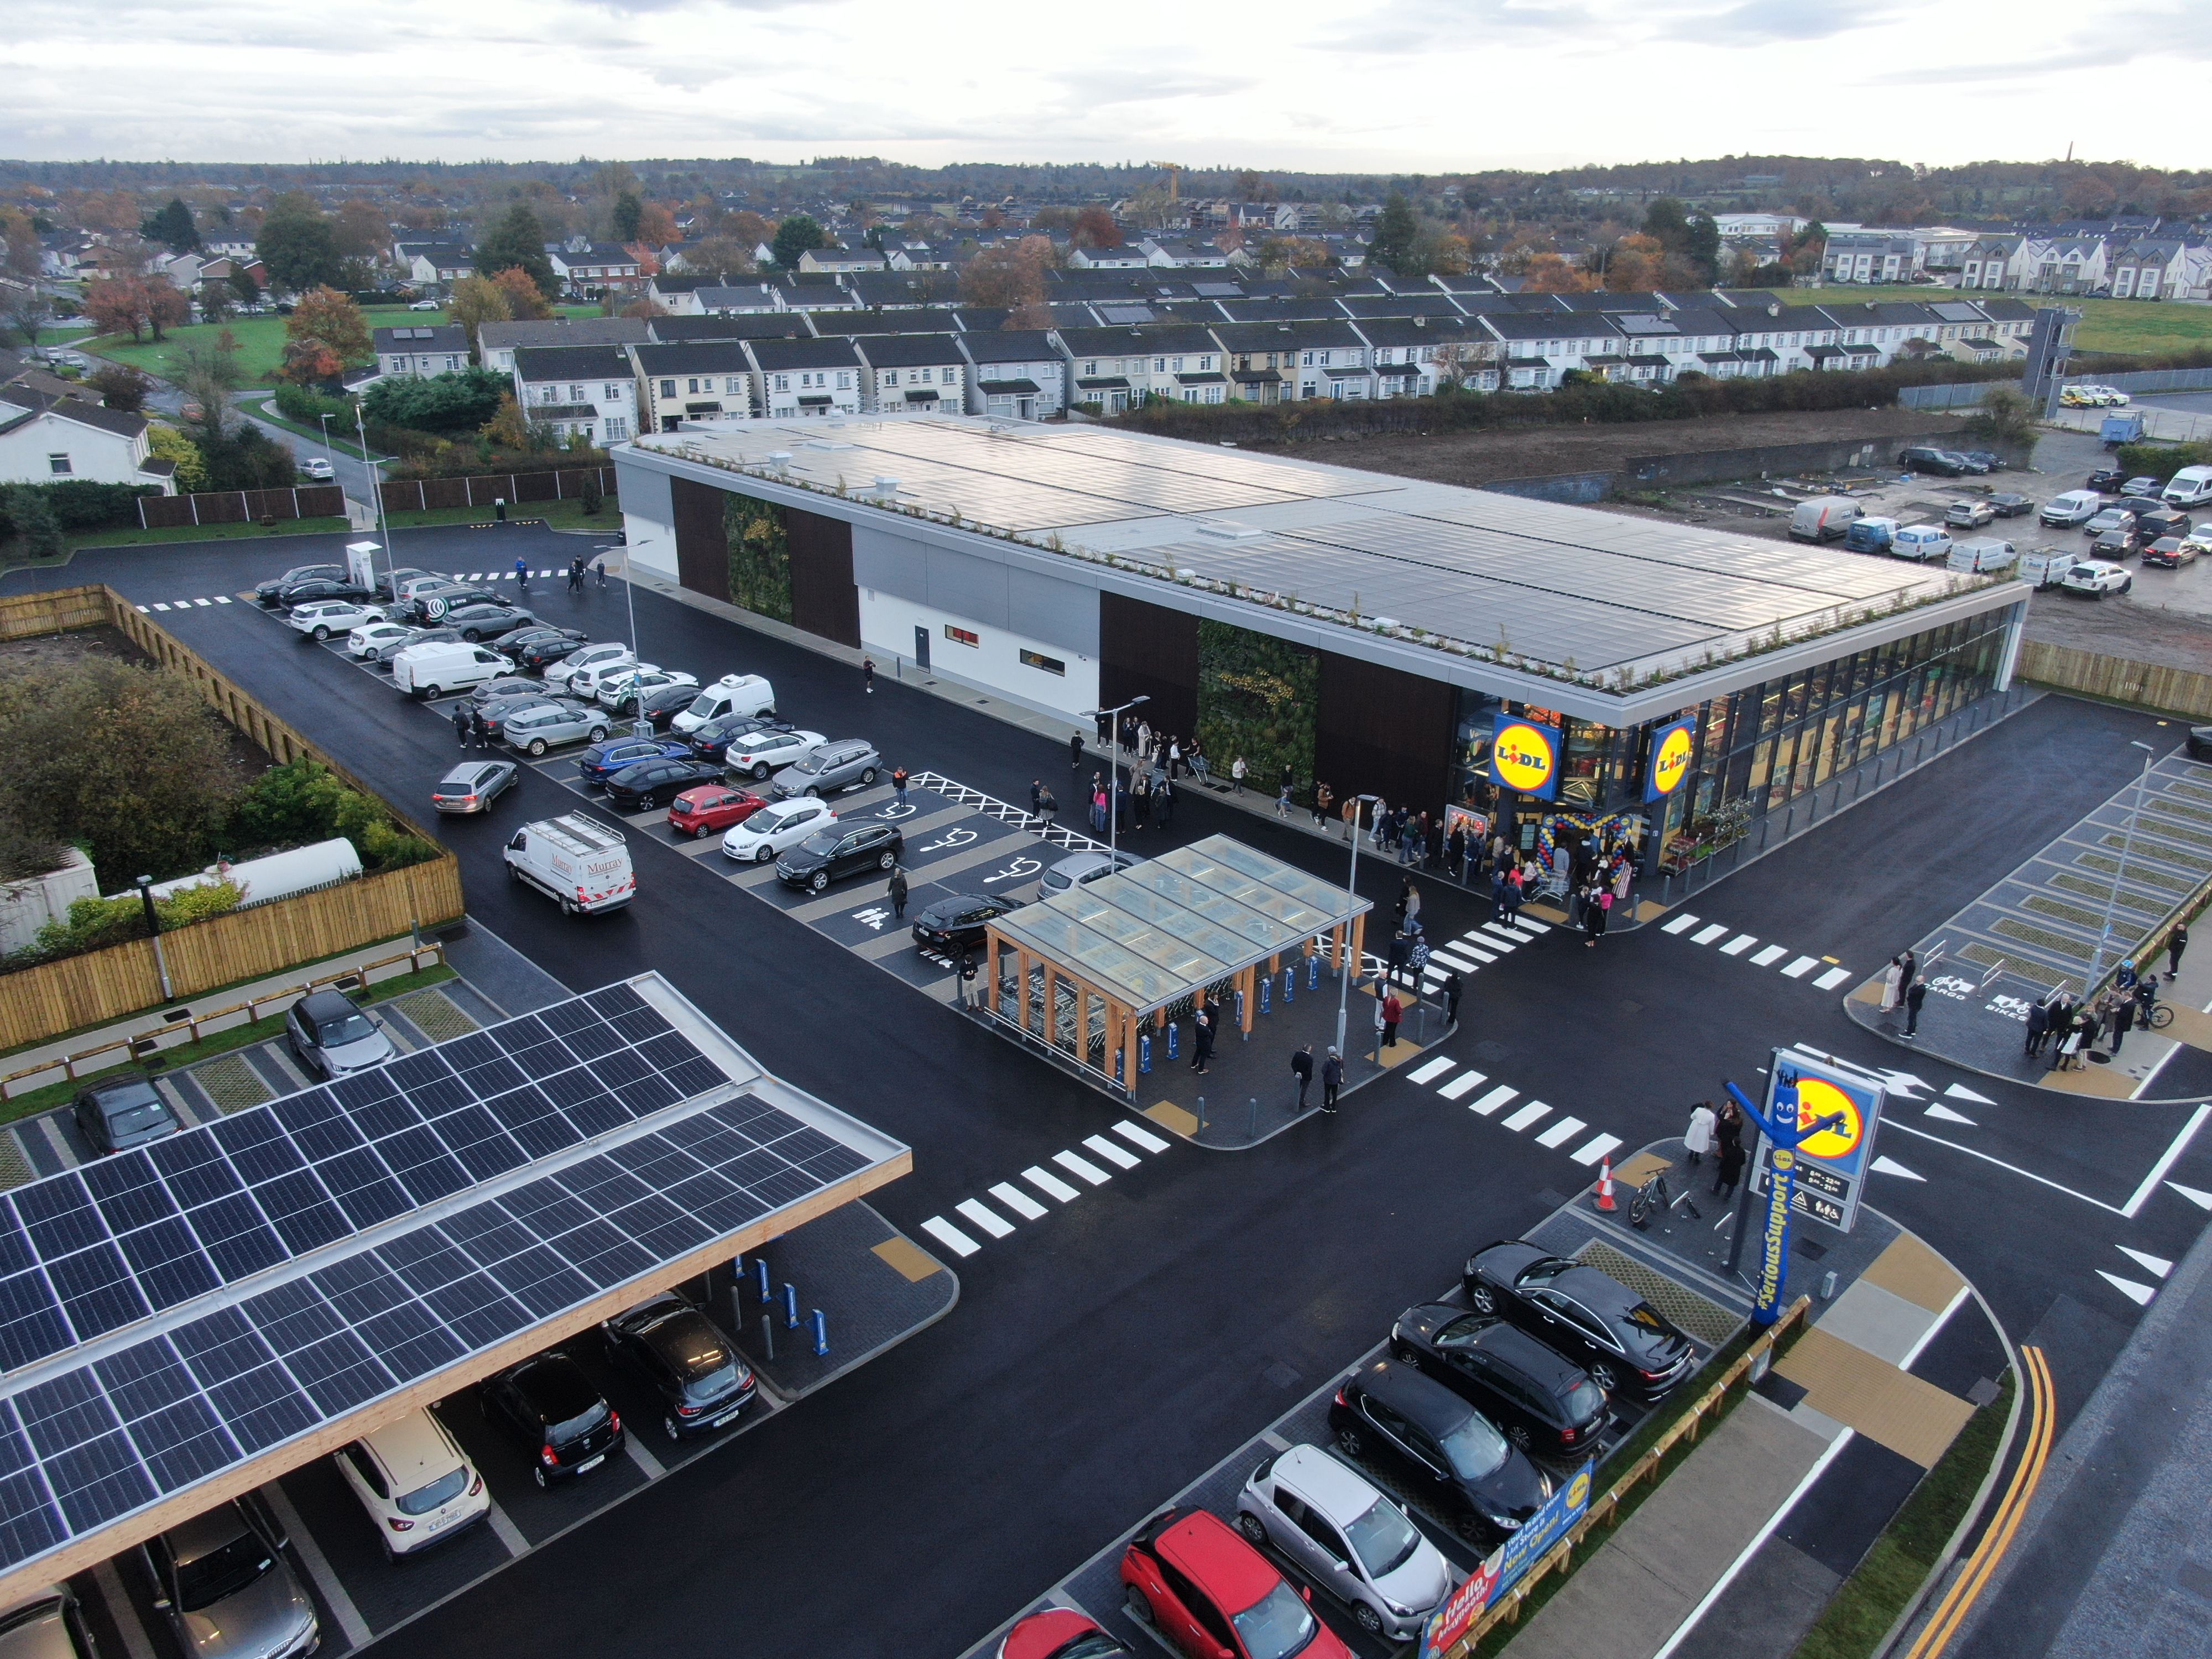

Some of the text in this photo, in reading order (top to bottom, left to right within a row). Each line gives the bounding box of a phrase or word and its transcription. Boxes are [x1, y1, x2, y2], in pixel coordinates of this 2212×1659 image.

[552, 853, 573, 873] Murray
[587, 858, 623, 874] Murray
[1924, 983, 1965, 1000] CARGO
[1985, 1004, 2028, 1021] BIKES
[1757, 1173, 1789, 1311] #SeriousSupport
[1504, 1545, 1527, 1574] Now
[1530, 1510, 1559, 1548] Open!
[1438, 1580, 1489, 1642] Maynooth!
[1446, 1577, 1483, 1625] Hello
